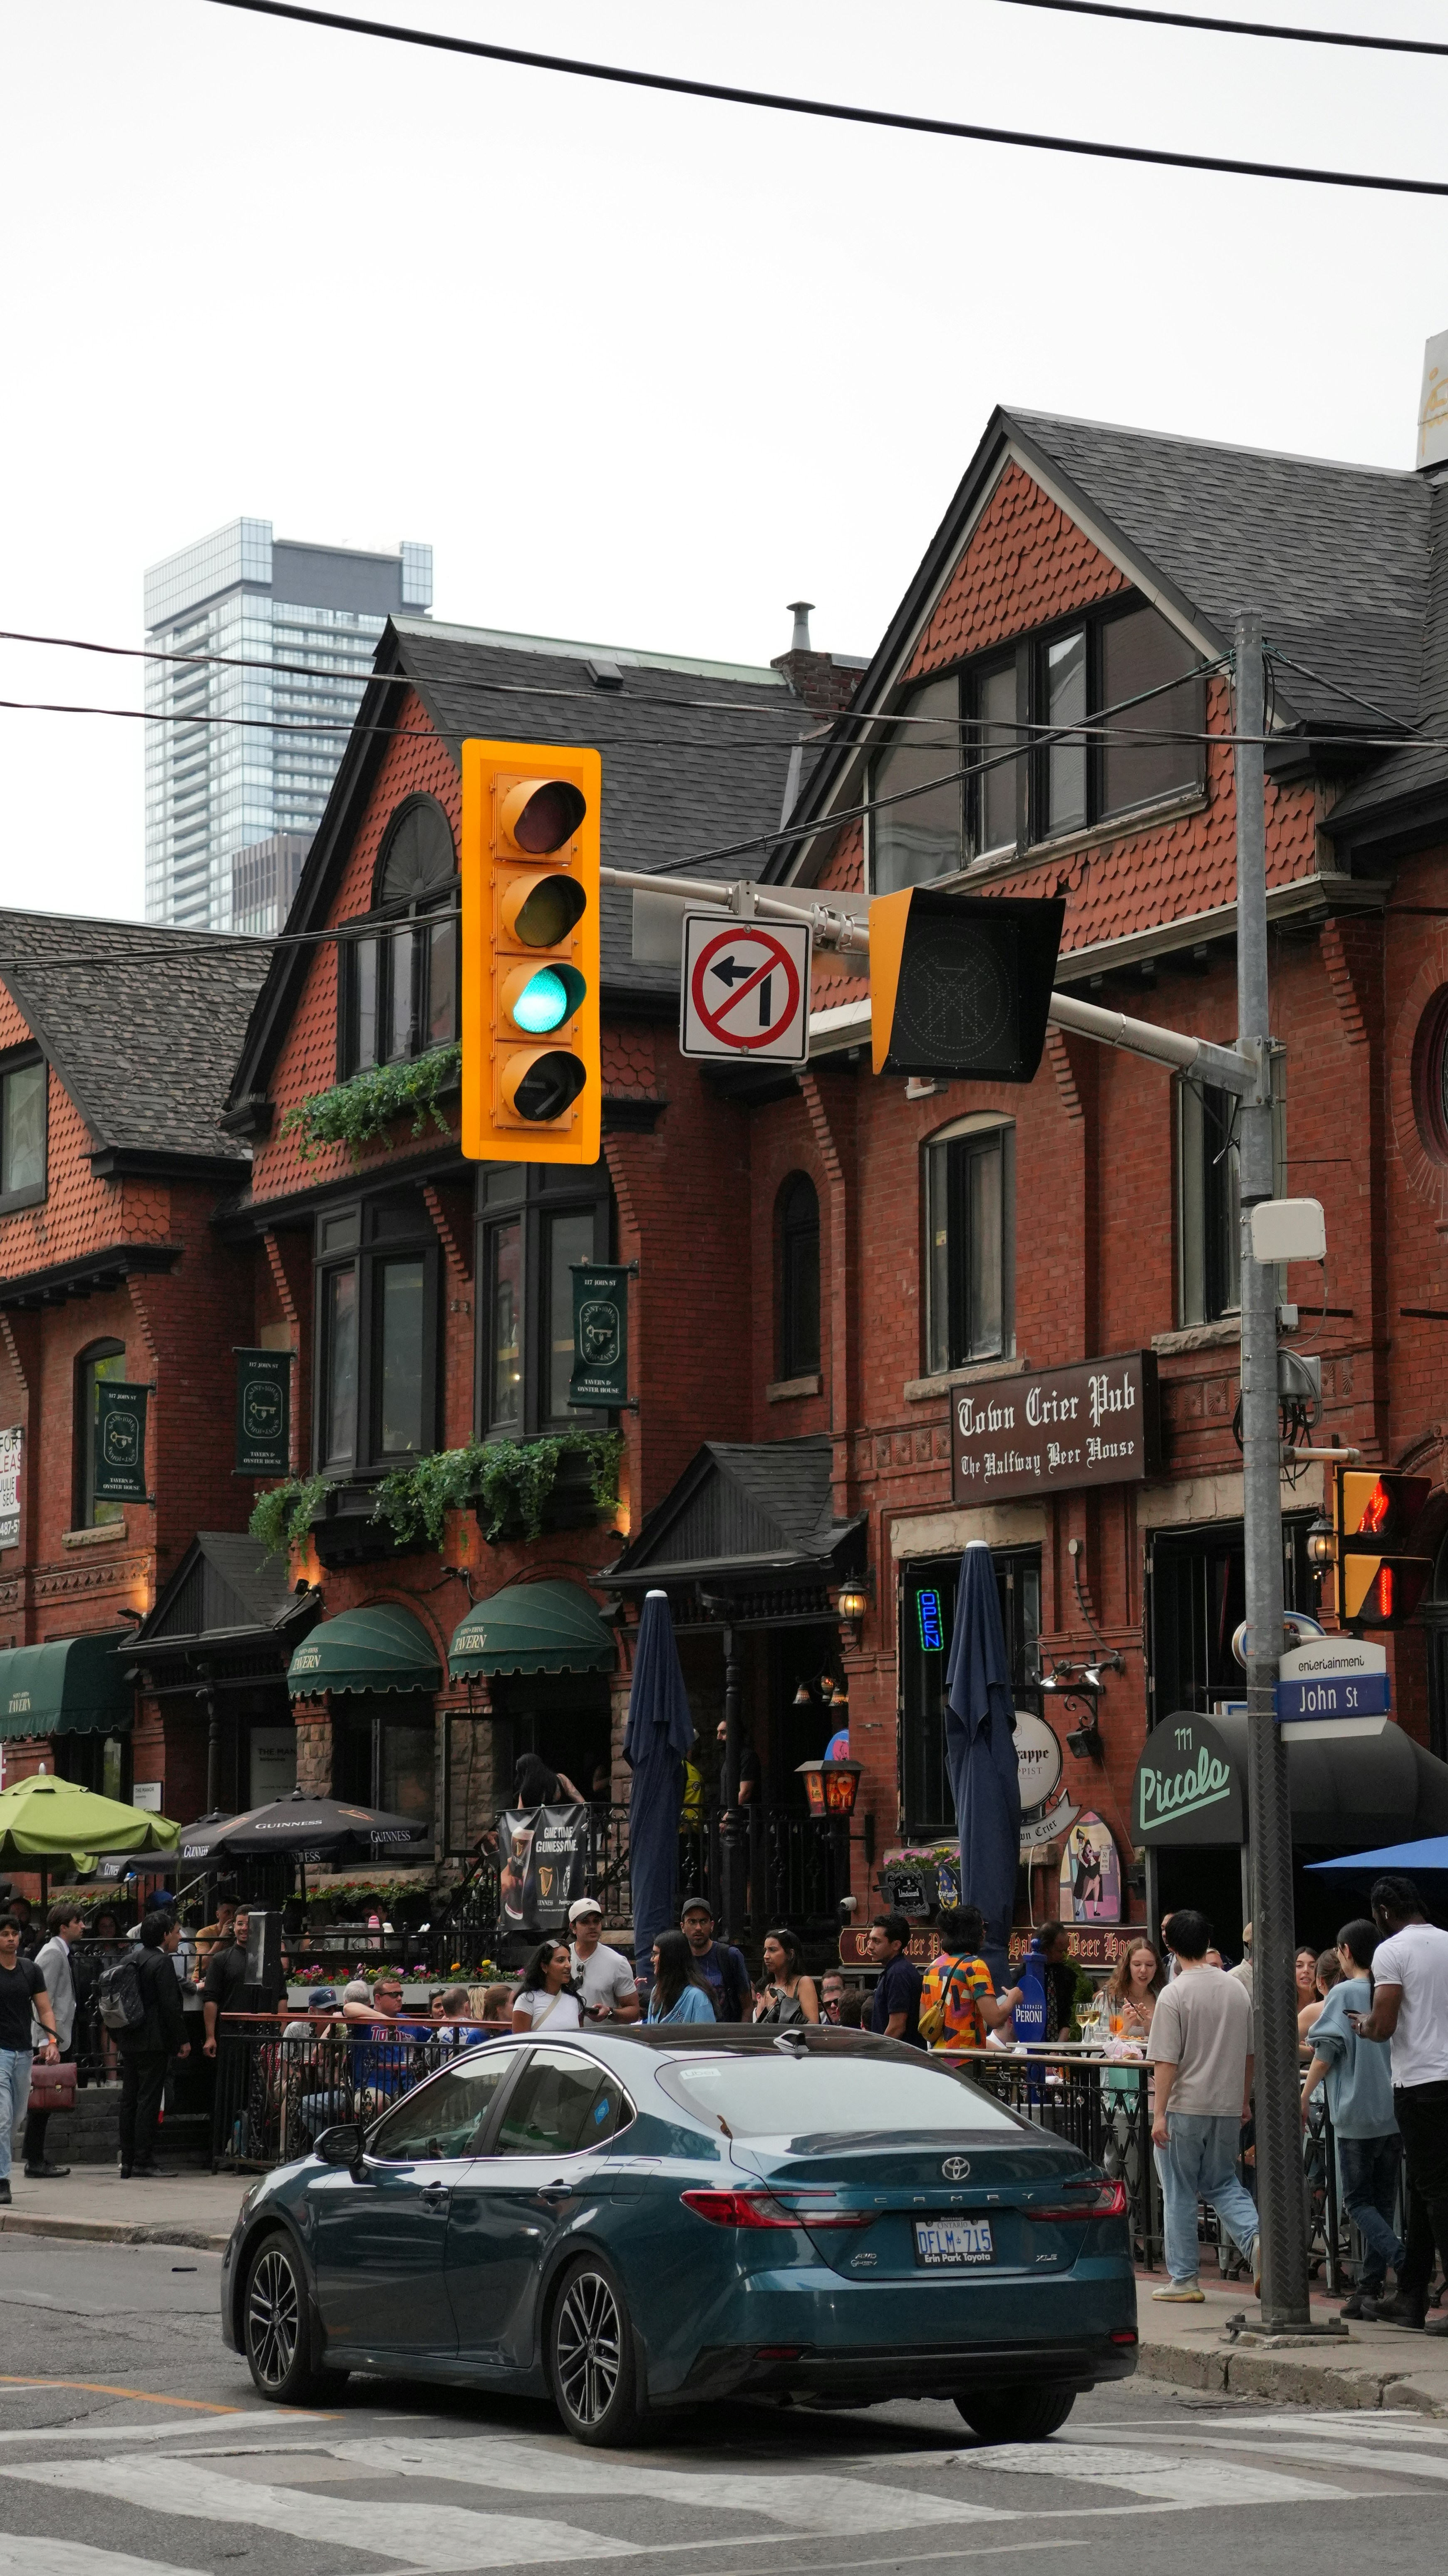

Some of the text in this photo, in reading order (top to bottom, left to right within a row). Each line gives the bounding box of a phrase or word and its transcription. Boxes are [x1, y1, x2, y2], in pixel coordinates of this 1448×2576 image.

[958, 1372, 1136, 1437] Town Crier Pub
[962, 1437, 1135, 1484] The Halfway Beer House
[2, 1492, 15, 1507] SEO
[922, 1593, 940, 1647] OPEN
[454, 1635, 487, 1651] TAVERN
[292, 1655, 322, 1671] TAVERN
[1299, 1655, 1364, 1671] entertainment
[9, 1698, 30, 1713] TAVERN
[1299, 1684, 1358, 1712] John St
[1174, 1727, 1192, 1751] 111
[1140, 1746, 1230, 1830] Piccolo
[255, 1820, 322, 1829] GUINNESS
[1035, 1820, 1057, 1836] Crier
[370, 1830, 411, 1843] GUINNESS
[1067, 1932, 1101, 1957] Beer
[1015, 2009, 1042, 2023] PERONI
[874, 2193, 1034, 2204] CAMRY
[963, 2229, 992, 2252] 715
[925, 2253, 991, 2263] Erin Park Toyota
